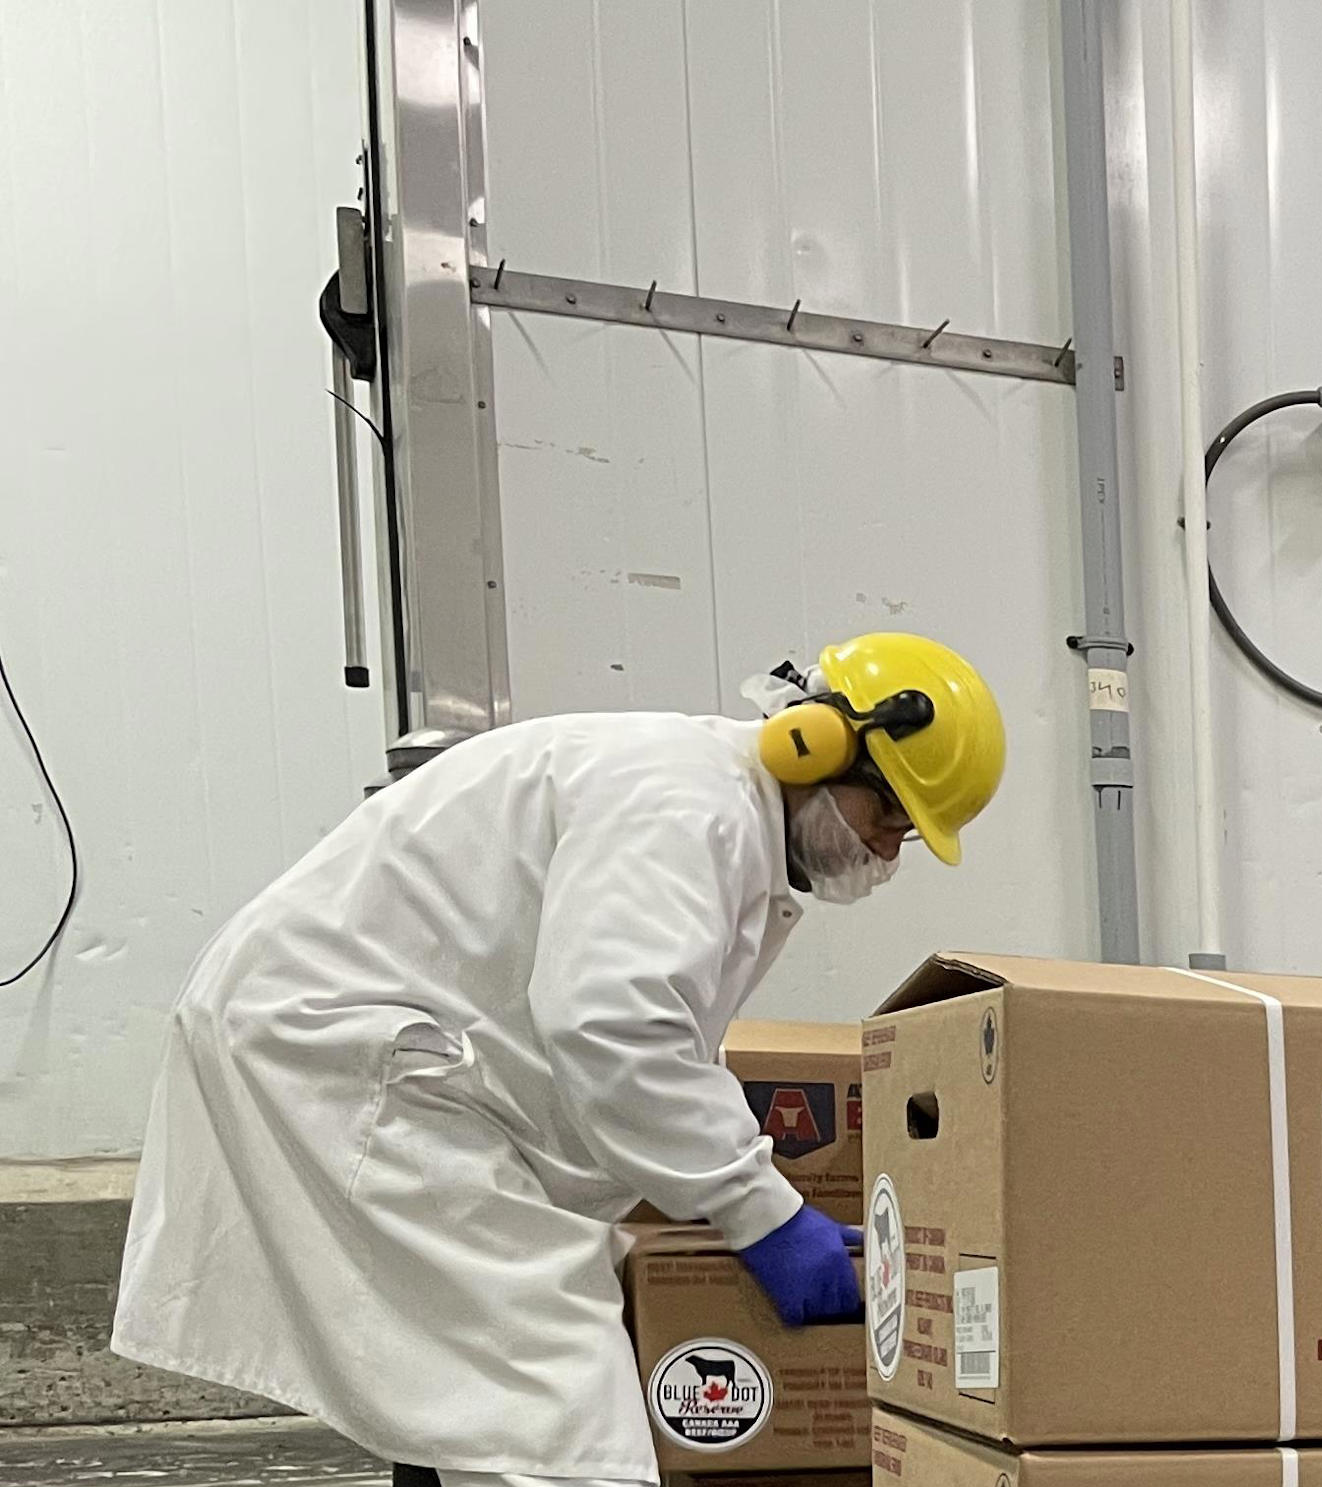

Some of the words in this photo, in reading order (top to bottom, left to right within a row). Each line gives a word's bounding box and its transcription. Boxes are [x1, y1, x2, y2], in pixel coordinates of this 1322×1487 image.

[664, 1385, 700, 1401] BLUE
[731, 1386, 758, 1402] DOT
[722, 1419, 740, 1428] AAA
